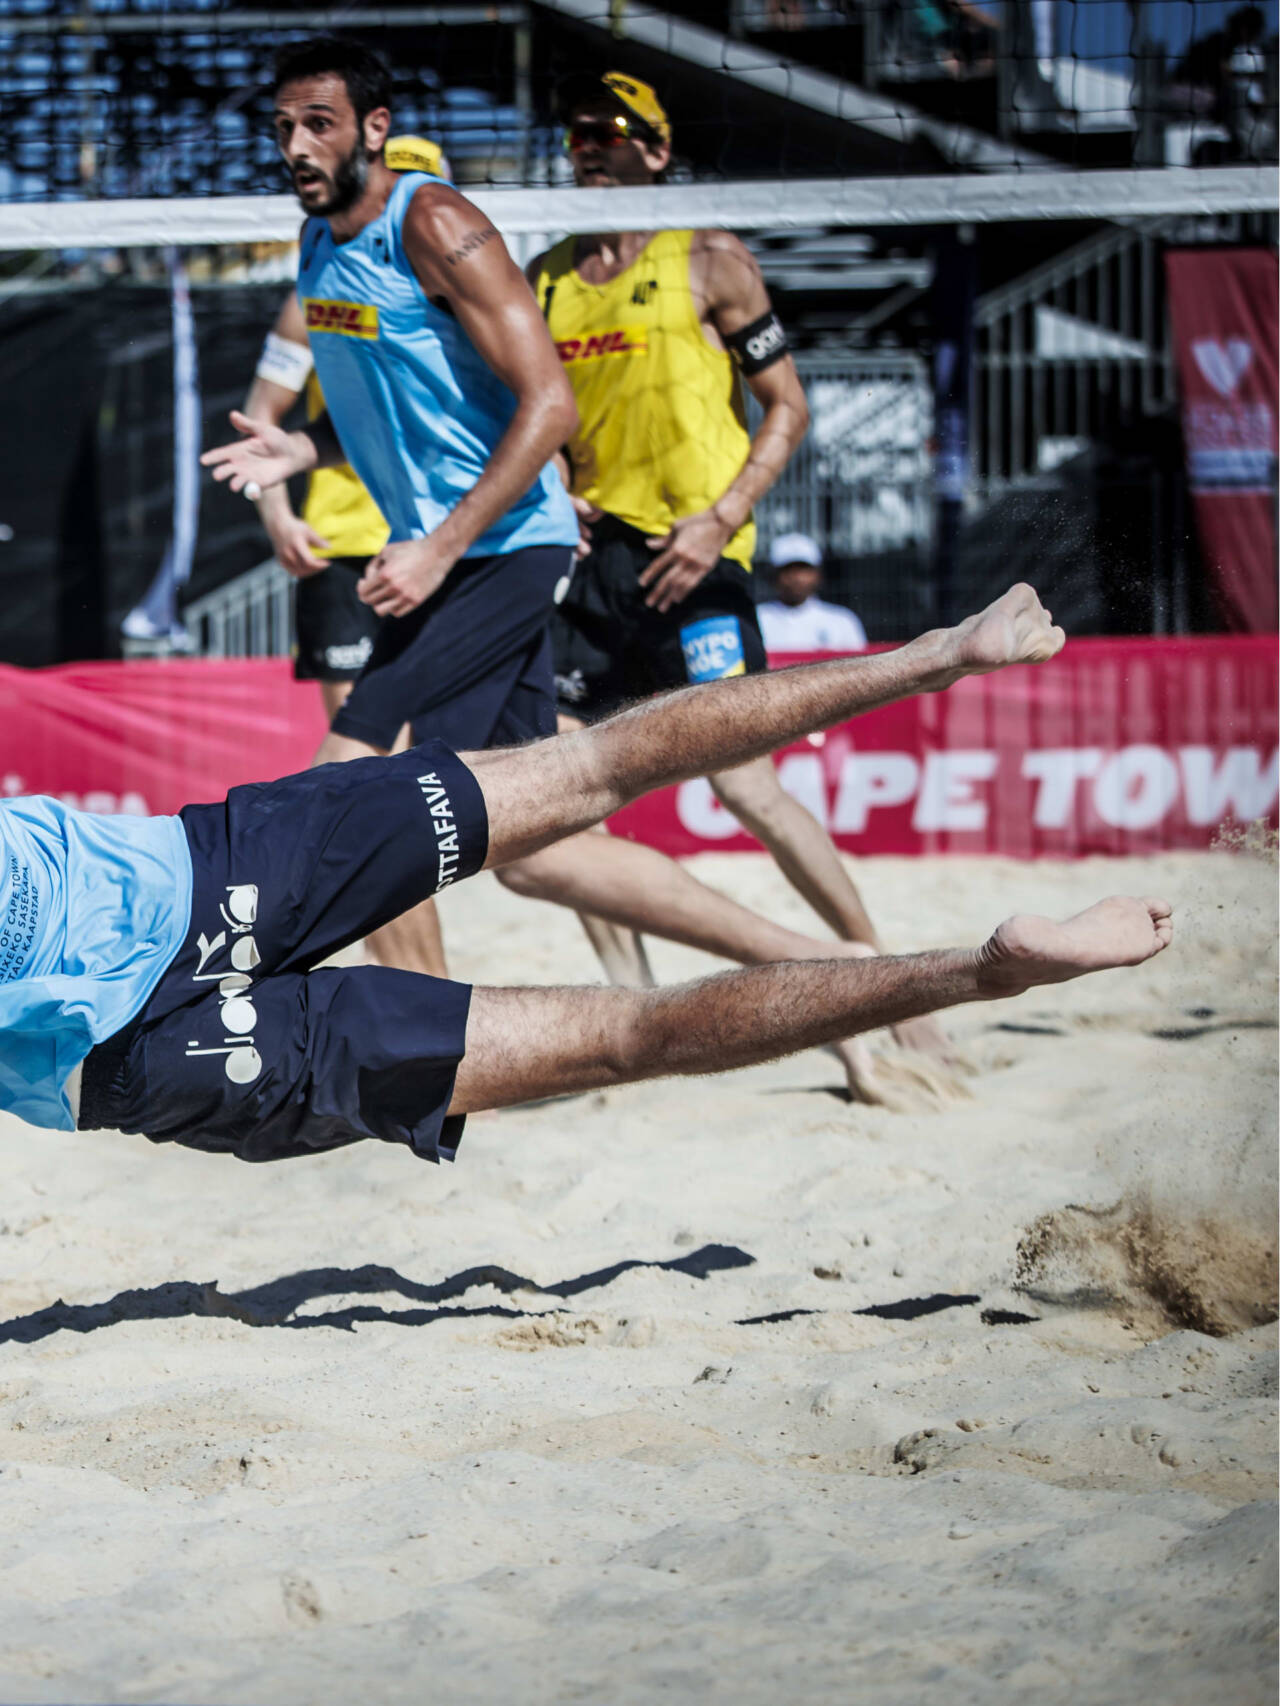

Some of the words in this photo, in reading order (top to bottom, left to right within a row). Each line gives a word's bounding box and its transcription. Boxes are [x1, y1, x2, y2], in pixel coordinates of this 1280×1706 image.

[306, 303, 362, 332] DHL
[556, 331, 631, 362] DHL
[417, 772, 459, 892] OTTAFAVA
[11, 856, 21, 888] TOWN
[7, 892, 21, 925] CAPE
[0, 928, 12, 947] OF
[5, 956, 25, 983] TAD
[22, 886, 39, 952] KAAPSTAD
[185, 884, 262, 1084] diadora
